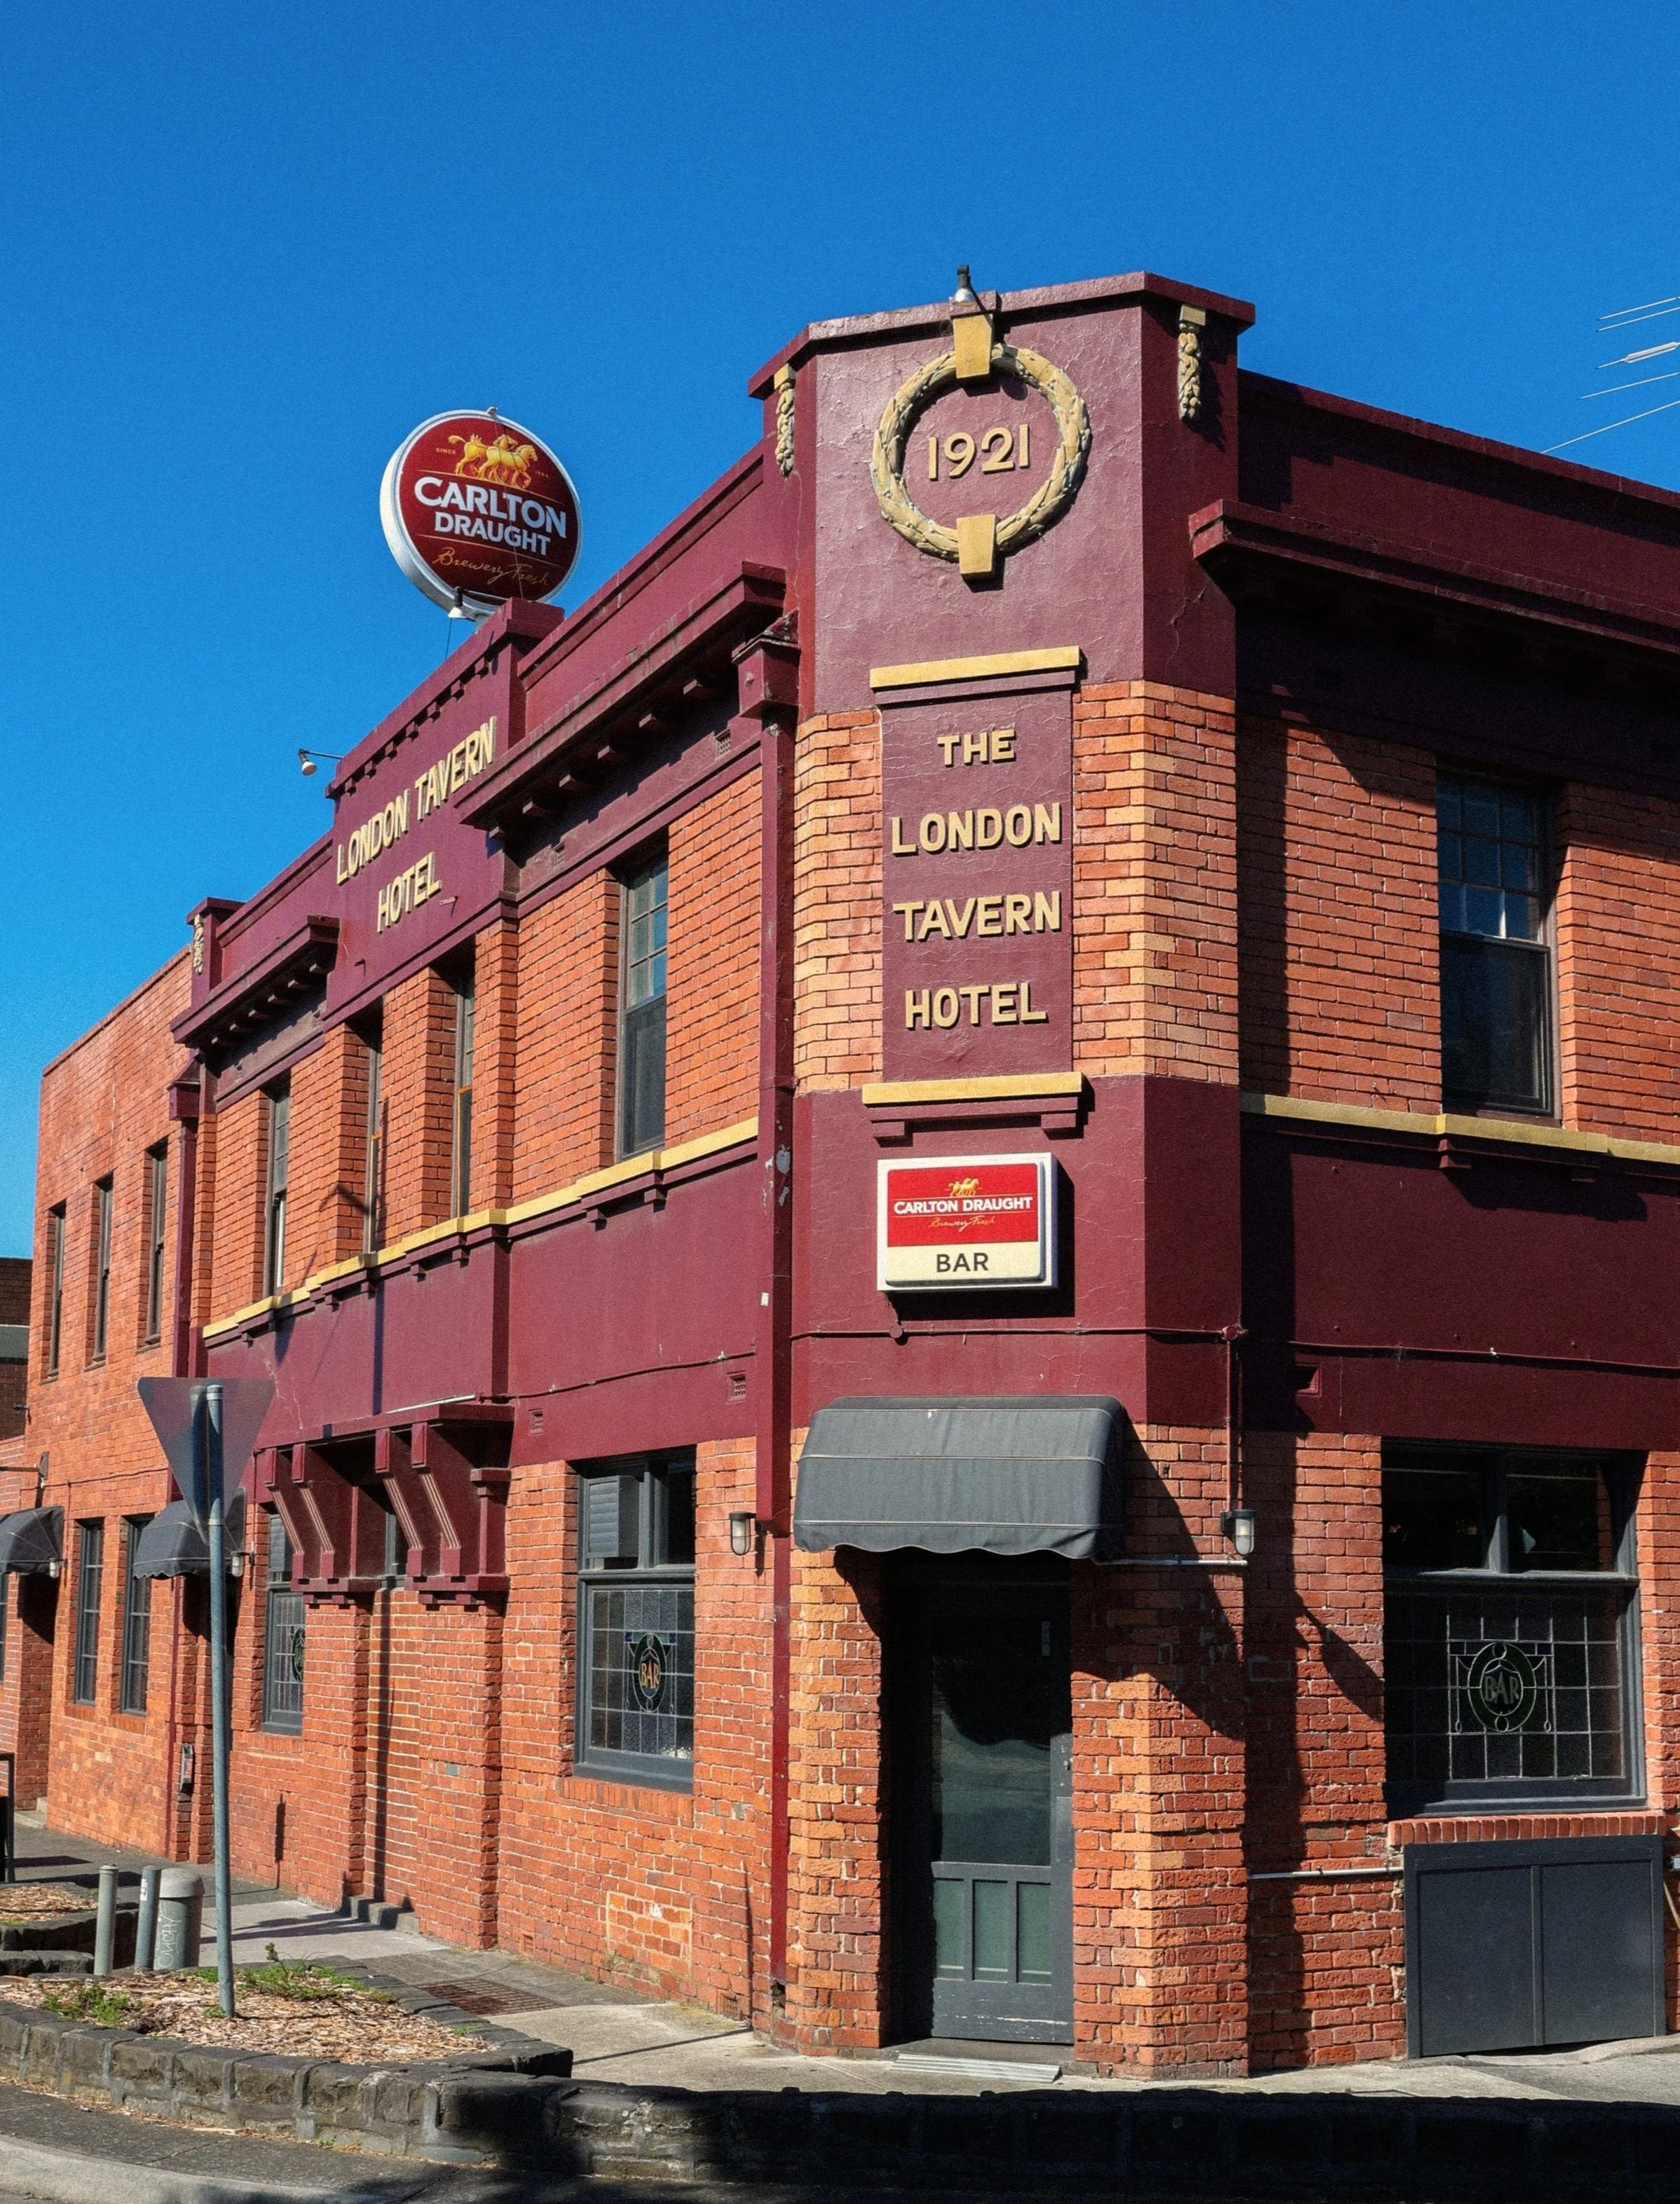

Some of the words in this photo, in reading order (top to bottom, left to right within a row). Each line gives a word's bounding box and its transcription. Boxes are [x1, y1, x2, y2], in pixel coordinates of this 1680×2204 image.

[928, 423, 1030, 480] 1921
[414, 476, 566, 538] CARLTON
[435, 511, 550, 556] DRAUGHT
[432, 547, 507, 585] Brewery
[507, 563, 549, 585] Fresh
[937, 729, 1016, 765] THE
[336, 788, 411, 884] LONDON
[415, 716, 497, 820] TAVERN
[891, 802, 1061, 855] LONDON
[377, 852, 442, 933] HOTEL
[893, 891, 1061, 941] TAVERN
[905, 982, 1048, 1029] HOTEL
[894, 1199, 958, 1214] CARLTON
[962, 1196, 1032, 1212] DRAUGHT
[936, 1252, 989, 1273] BAR
[641, 1659, 660, 1689] BAR
[1484, 1671, 1519, 1704] BAR
